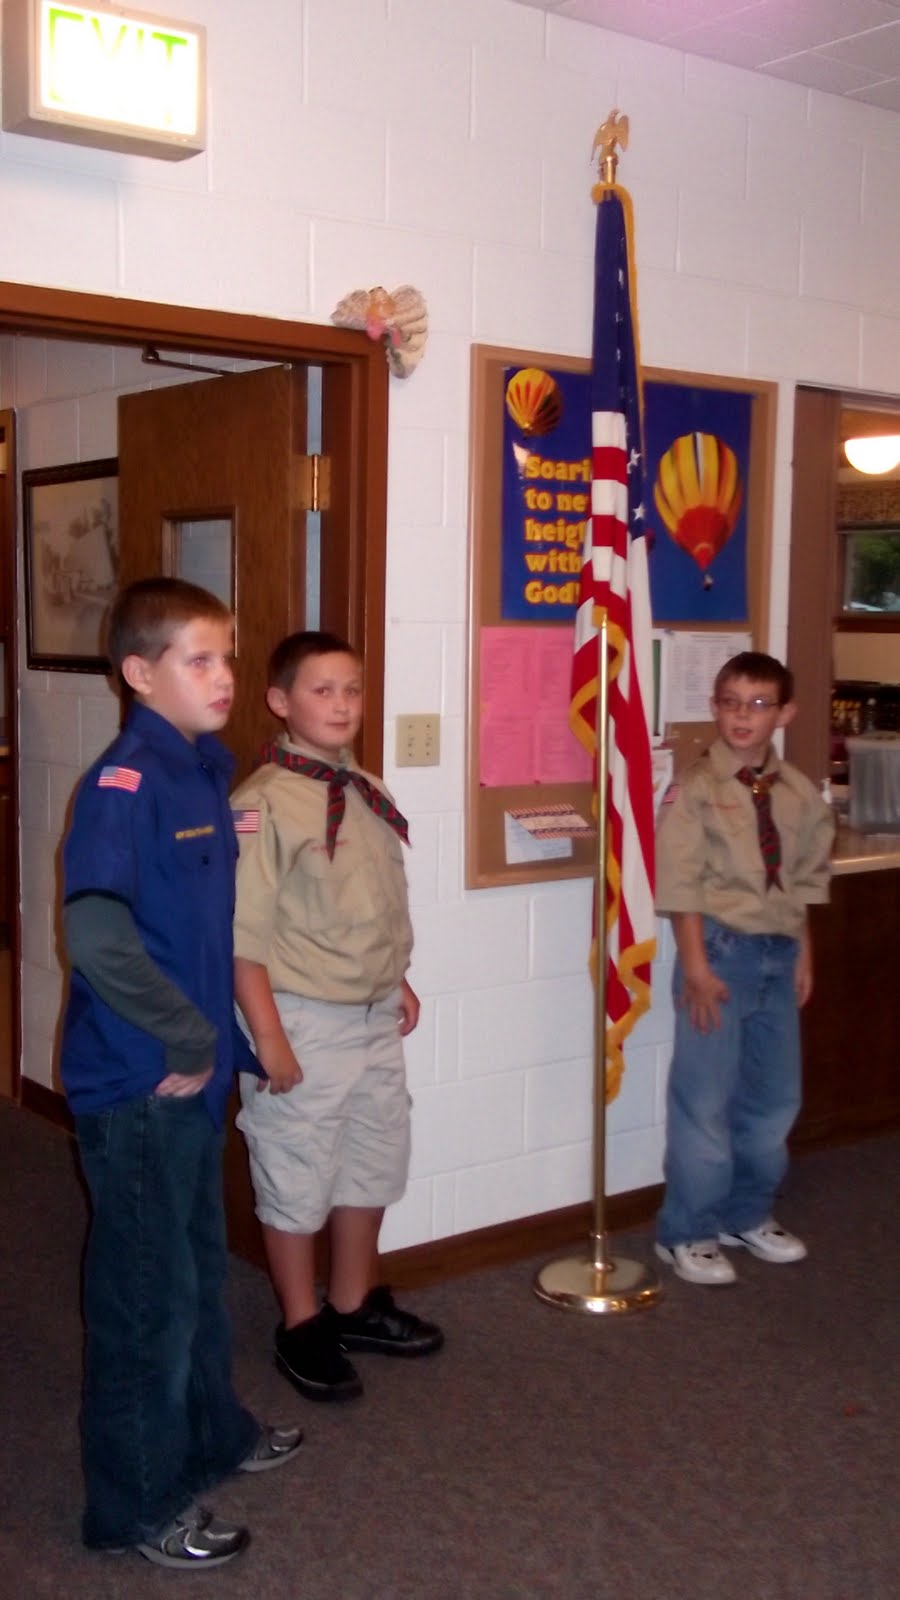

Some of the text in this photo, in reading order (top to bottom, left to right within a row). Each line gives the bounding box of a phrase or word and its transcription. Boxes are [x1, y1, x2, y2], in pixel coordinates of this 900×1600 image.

[525, 454, 592, 483] Soari
[524, 488, 588, 512] to ne
[524, 550, 582, 573] with
